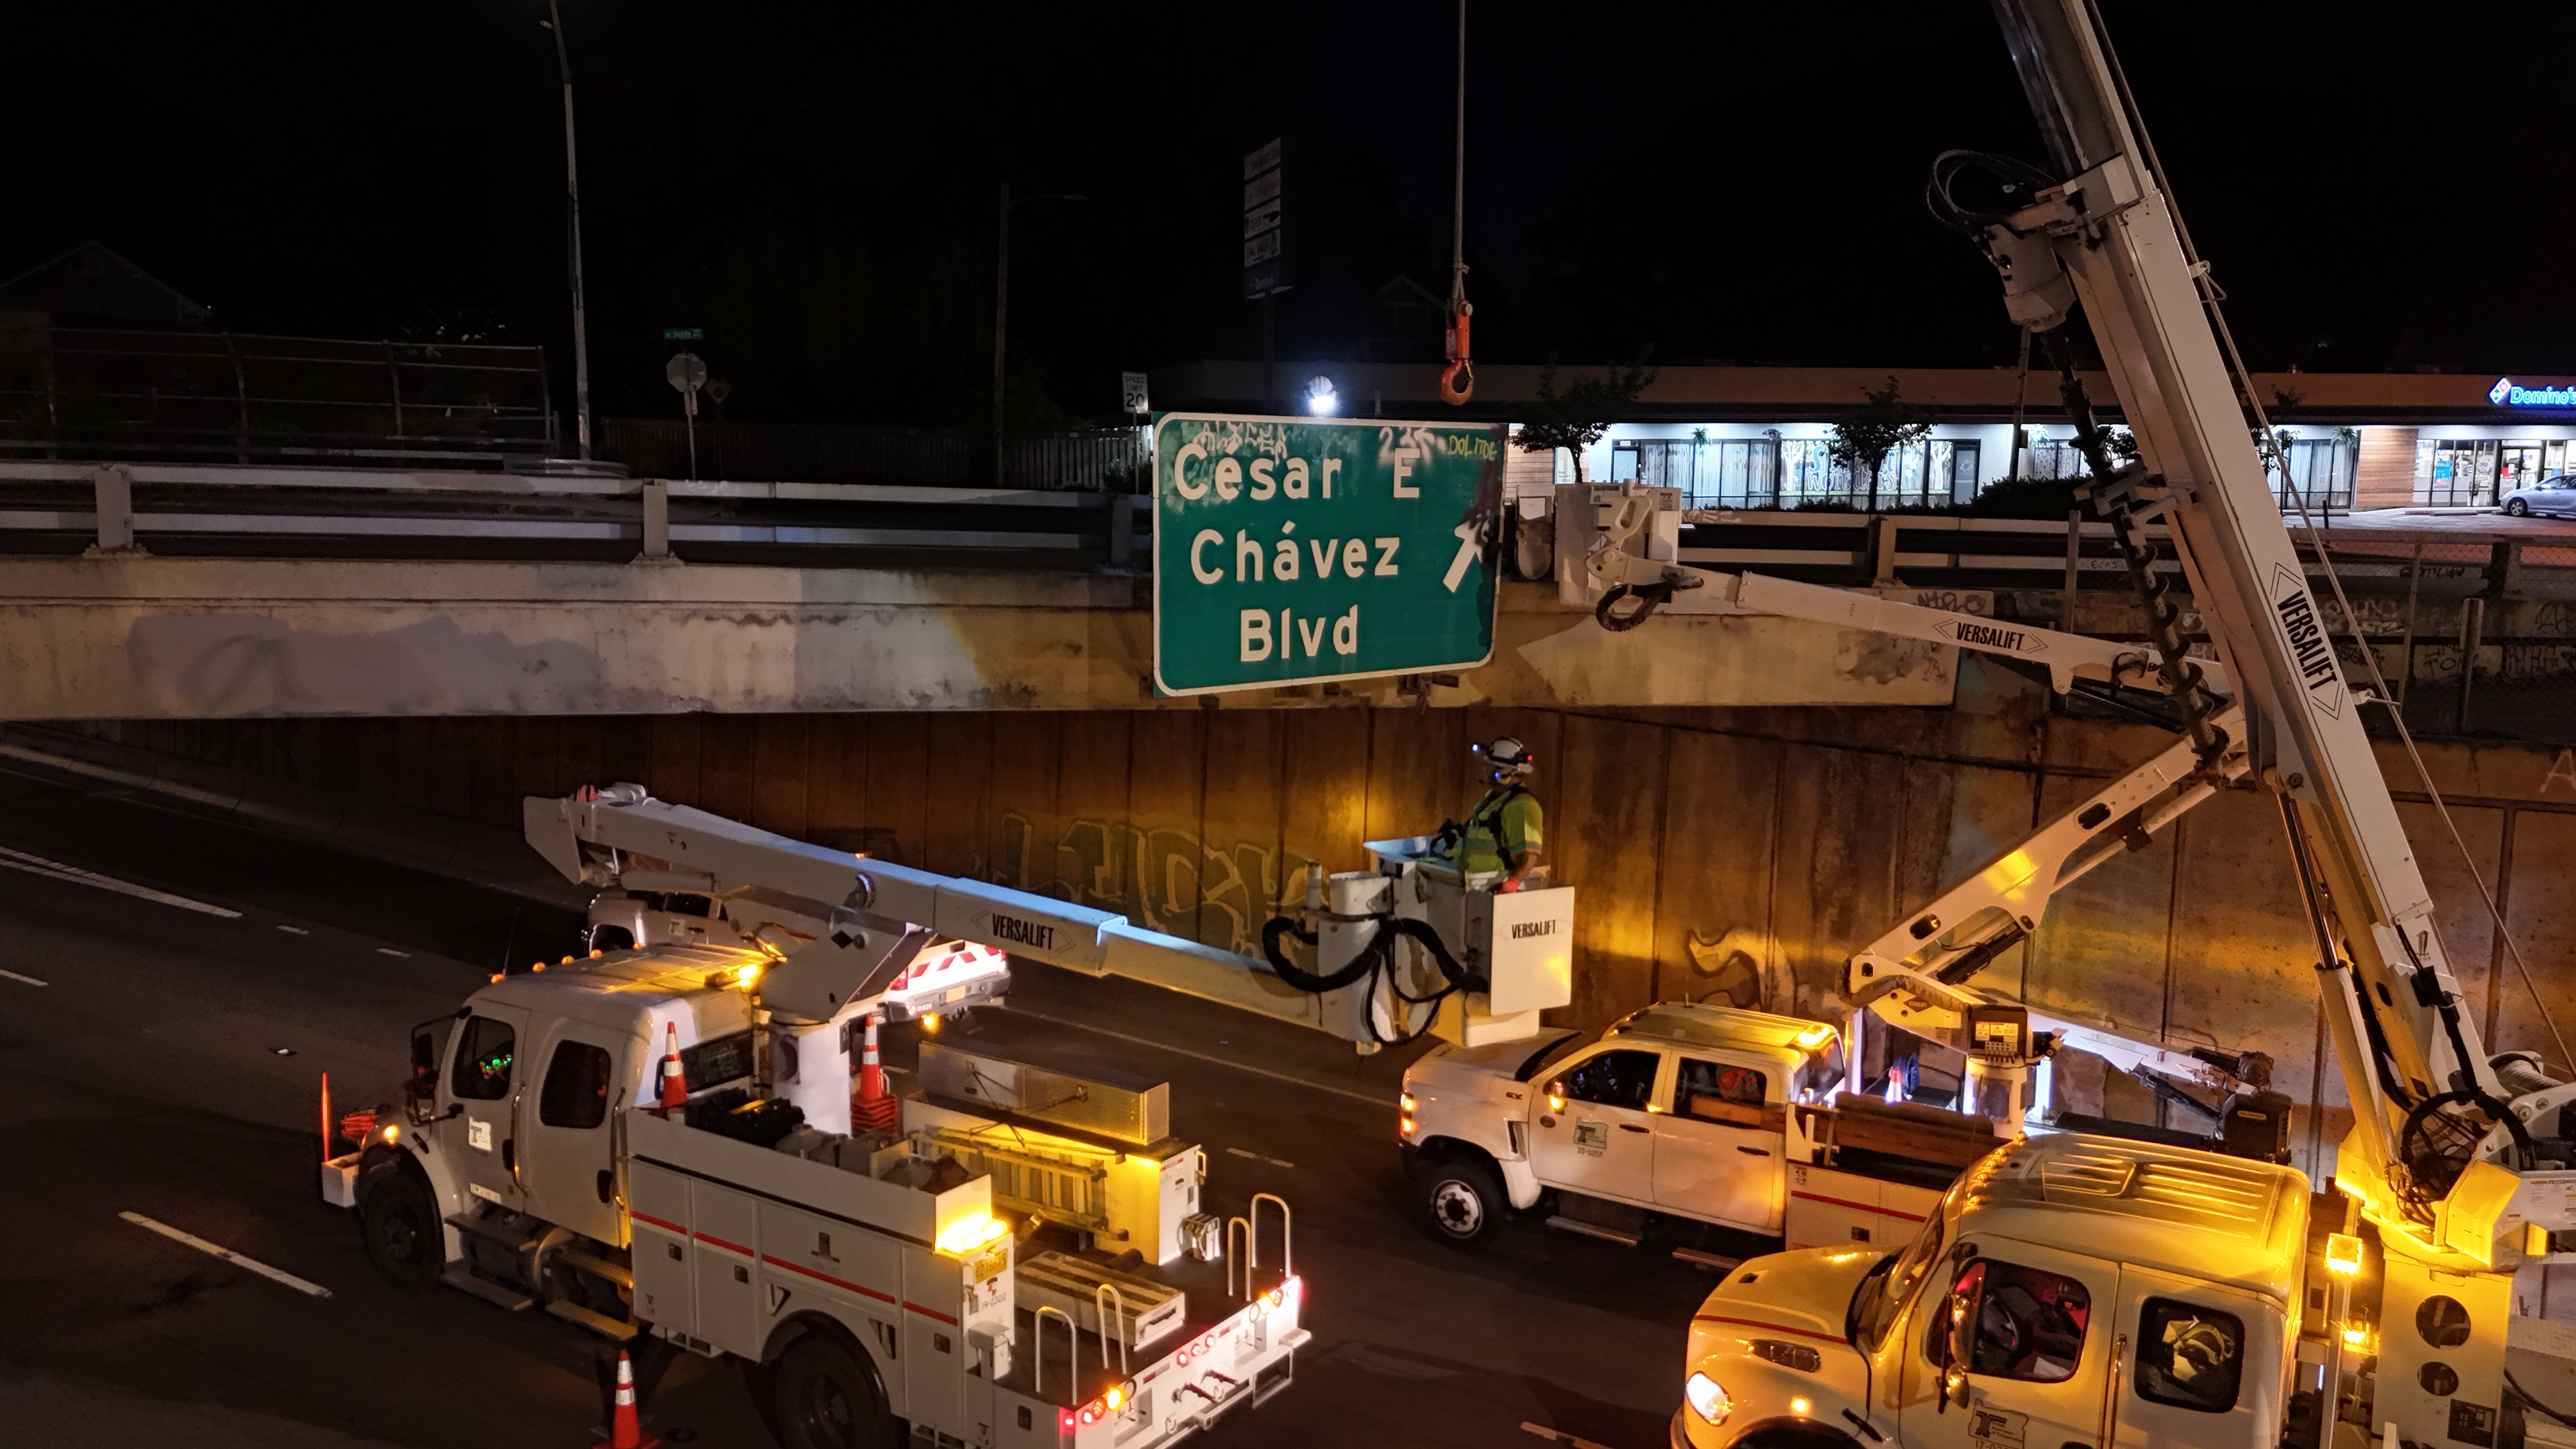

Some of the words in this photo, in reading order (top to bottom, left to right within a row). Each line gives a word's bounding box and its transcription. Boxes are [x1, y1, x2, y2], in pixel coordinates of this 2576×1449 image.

[1126, 392, 1145, 408] 20
[1174, 442, 1342, 500] César
[1393, 448, 1420, 498] E
[1190, 520, 1400, 585] Chávez
[1239, 604, 1359, 663] Blvd
[1956, 621, 2025, 651] VERSALIFT
[2277, 590, 2338, 691] VERSALIFT
[992, 912, 1055, 951] VERSALIFT
[1511, 919, 1557, 940] VERSALIFT
